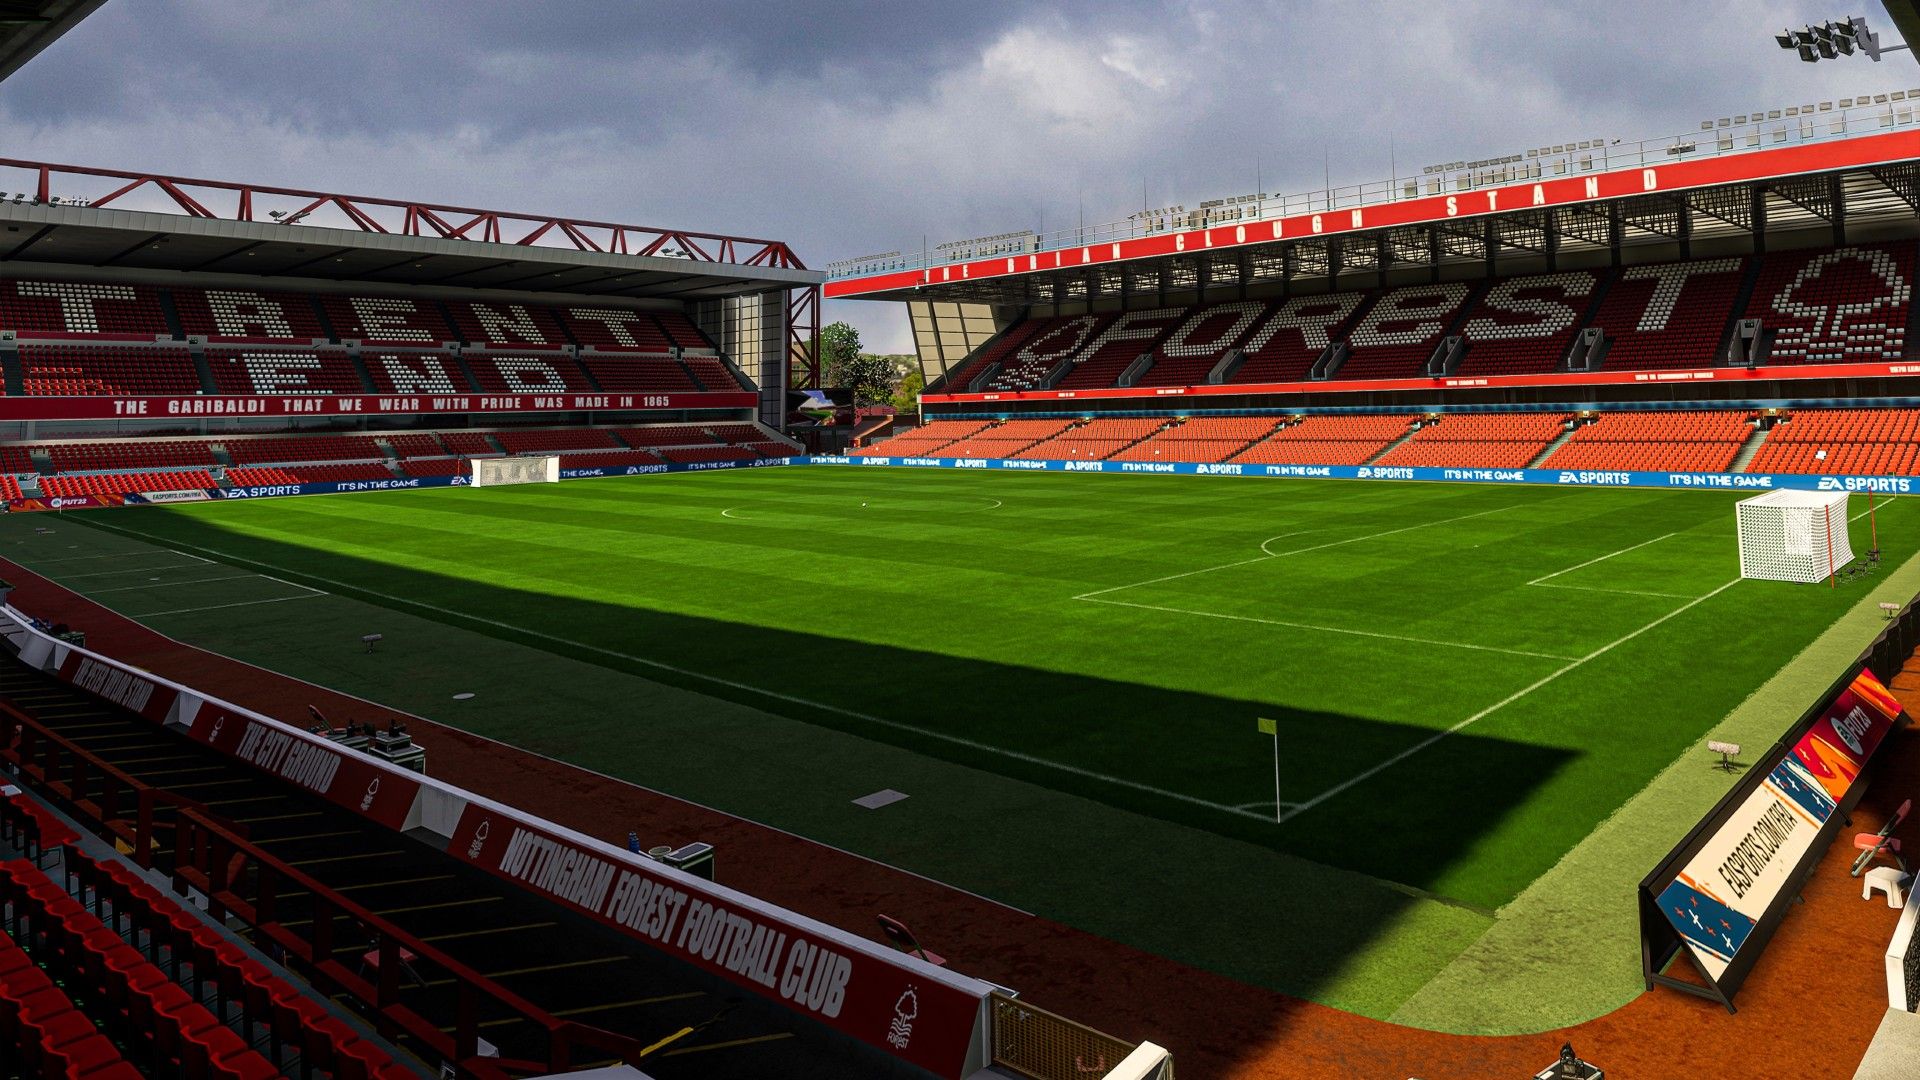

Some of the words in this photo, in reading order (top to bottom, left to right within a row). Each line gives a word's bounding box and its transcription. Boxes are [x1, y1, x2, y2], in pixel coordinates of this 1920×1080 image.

[925, 265, 968, 283] THE
[1008, 244, 1121, 273] BRIAN
[1175, 210, 1363, 252] CLOUGH
[1447, 169, 1656, 217] STAND
[114, 400, 148, 415] THE
[168, 399, 266, 414] GARIBALDI
[283, 399, 324, 413] THAT
[339, 399, 362, 412] WE
[379, 398, 419, 411] WEAR
[433, 398, 470, 410] WITH
[481, 397, 521, 409] PRIDE
[534, 397, 564, 409] WAS
[575, 396, 610, 408] MADE
[620, 396, 634, 407] IN
[643, 395, 670, 407] 1865
[626, 466, 639, 474] EA
[639, 465, 668, 473] SPORTS
[1076, 461, 1103, 471] SPORTS
[1196, 464, 1209, 474] EA
[1210, 464, 1242, 475] SPORTS
[1357, 467, 1371, 478] EA
[1374, 468, 1414, 479] SPORTS
[1474, 471, 1492, 480] THE
[1495, 471, 1524, 481] GAME
[1558, 472, 1579, 483] EA
[1580, 472, 1630, 484] SPORTS
[372, 481, 389, 489] THE
[391, 479, 419, 488] GAME
[451, 476, 468, 486] EA
[1709, 476, 1730, 486] THE
[1734, 476, 1772, 487] GAME
[1818, 477, 1843, 490] EA
[1845, 477, 1911, 492] SPORTS
[228, 488, 248, 499] EA
[250, 486, 300, 498] SPORTS
[236, 721, 267, 762] THE
[255, 729, 293, 773] CITY
[280, 740, 342, 794] GROUND
[1718, 800, 1798, 899] EASPORTS.COM/FIFA
[499, 827, 618, 913] NOTTINGHAM
[606, 867, 689, 945] FOREST
[677, 900, 787, 988] FOOTBALL
[779, 938, 852, 1019] CLUB
[887, 1031, 909, 1049] FOREST
